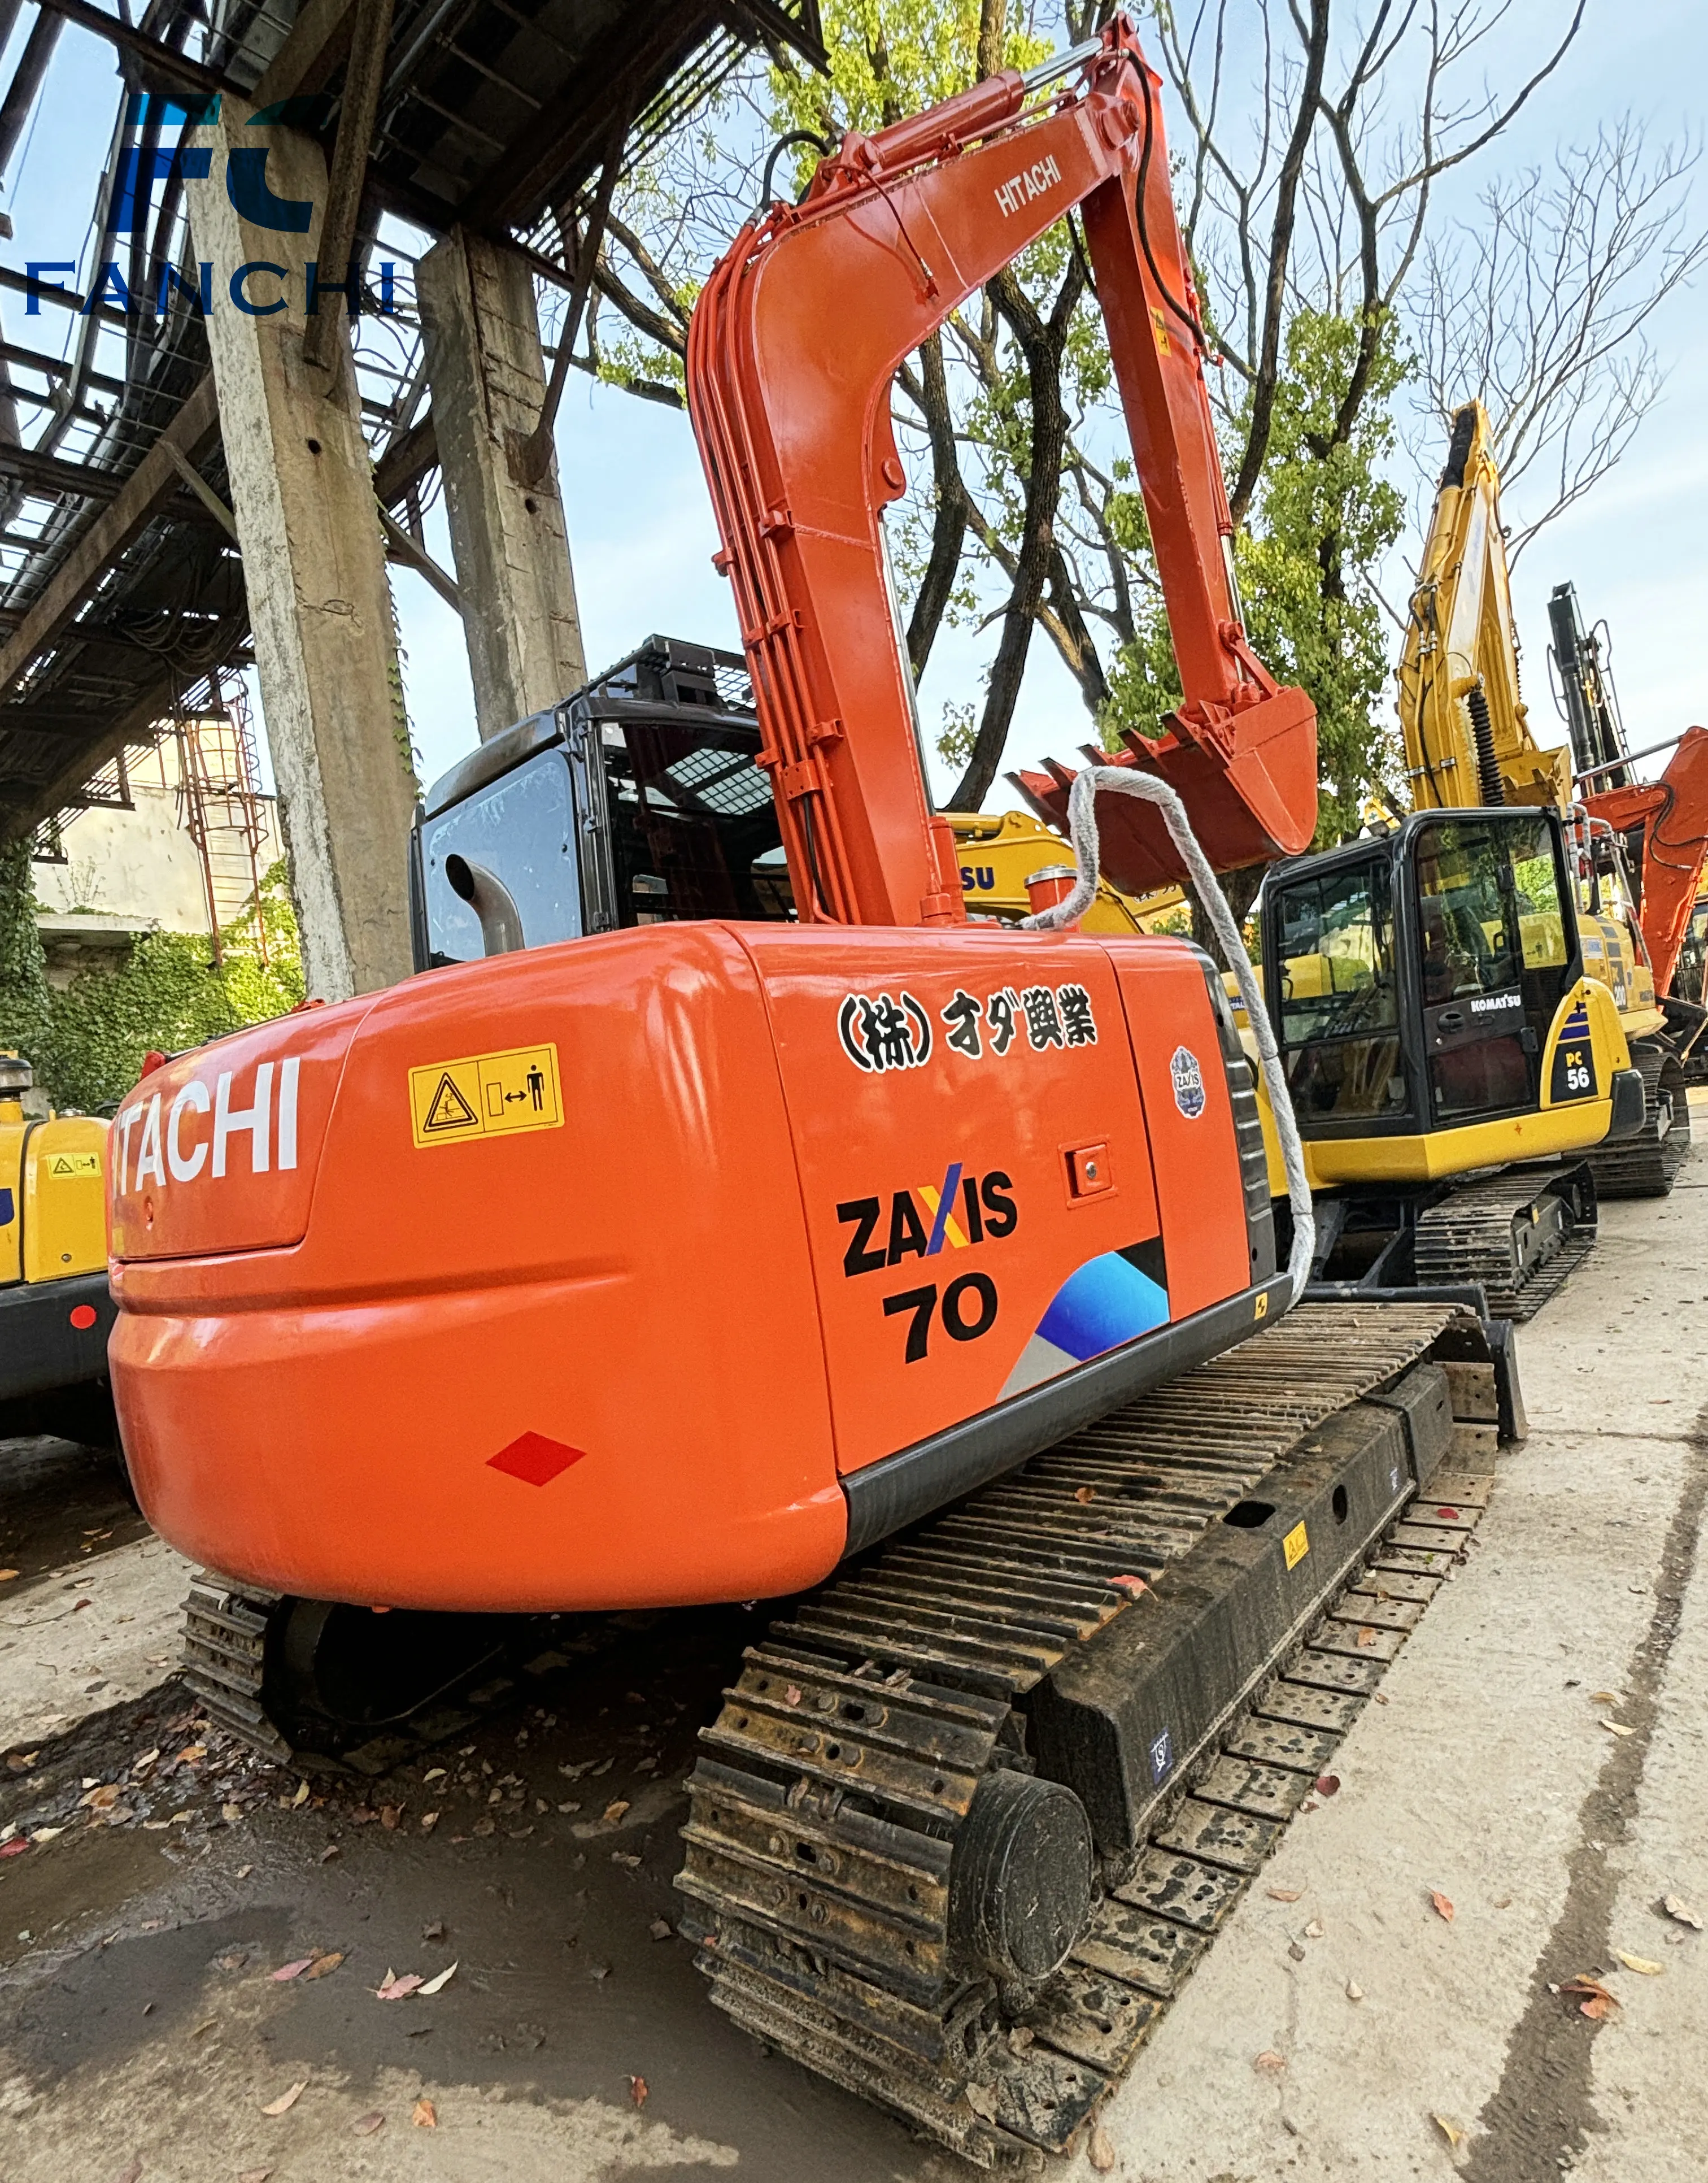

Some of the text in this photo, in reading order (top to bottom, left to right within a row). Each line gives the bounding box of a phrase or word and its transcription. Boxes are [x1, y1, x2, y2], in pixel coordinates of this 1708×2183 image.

[994, 154, 1062, 218] HITACHI
[1470, 993, 1522, 1012] KOMATSU
[1566, 1051, 1583, 1067] PC
[1567, 1067, 1589, 1090] 56
[836, 1162, 1018, 1277] ZAXIS
[882, 1271, 999, 1364] 70
